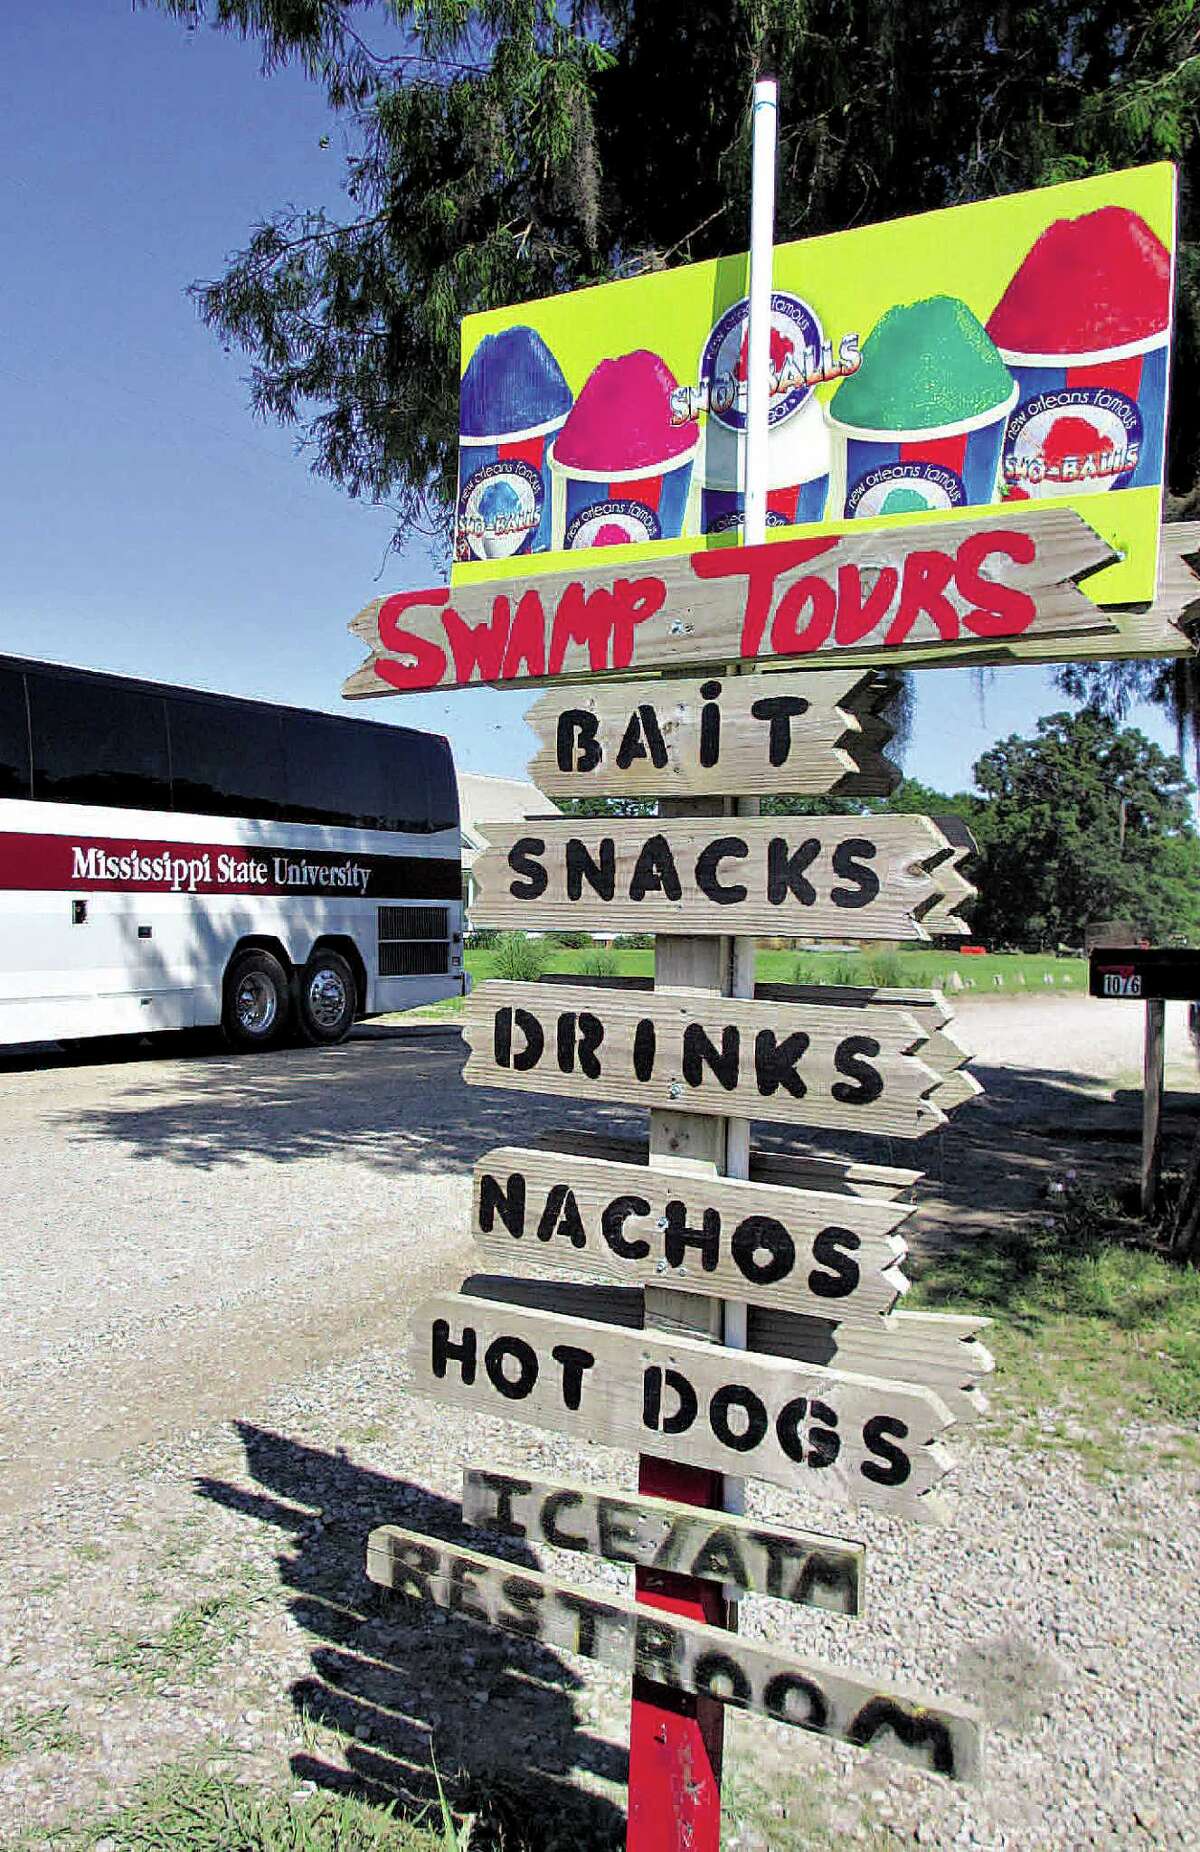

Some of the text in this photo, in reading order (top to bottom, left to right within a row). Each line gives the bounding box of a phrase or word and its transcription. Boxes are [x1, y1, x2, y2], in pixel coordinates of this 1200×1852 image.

[1007, 388, 1137, 441] new orleans famous
[461, 481, 475, 504] new
[475, 463, 513, 482] orleans
[848, 463, 961, 509] new orleans famous
[1005, 442, 1139, 484] SNO-BALLS
[567, 501, 657, 542] new orleans famous
[374, 530, 1037, 689] SWAMP TOURS
[71, 846, 373, 895] Mississippi State University
[508, 833, 880, 909] SNACKS
[494, 1006, 885, 1105] DRINKS
[479, 1172, 862, 1298] NACHOS
[432, 1318, 912, 1487] HOT DOGS
[390, 1536, 954, 1780] RESTROOM
